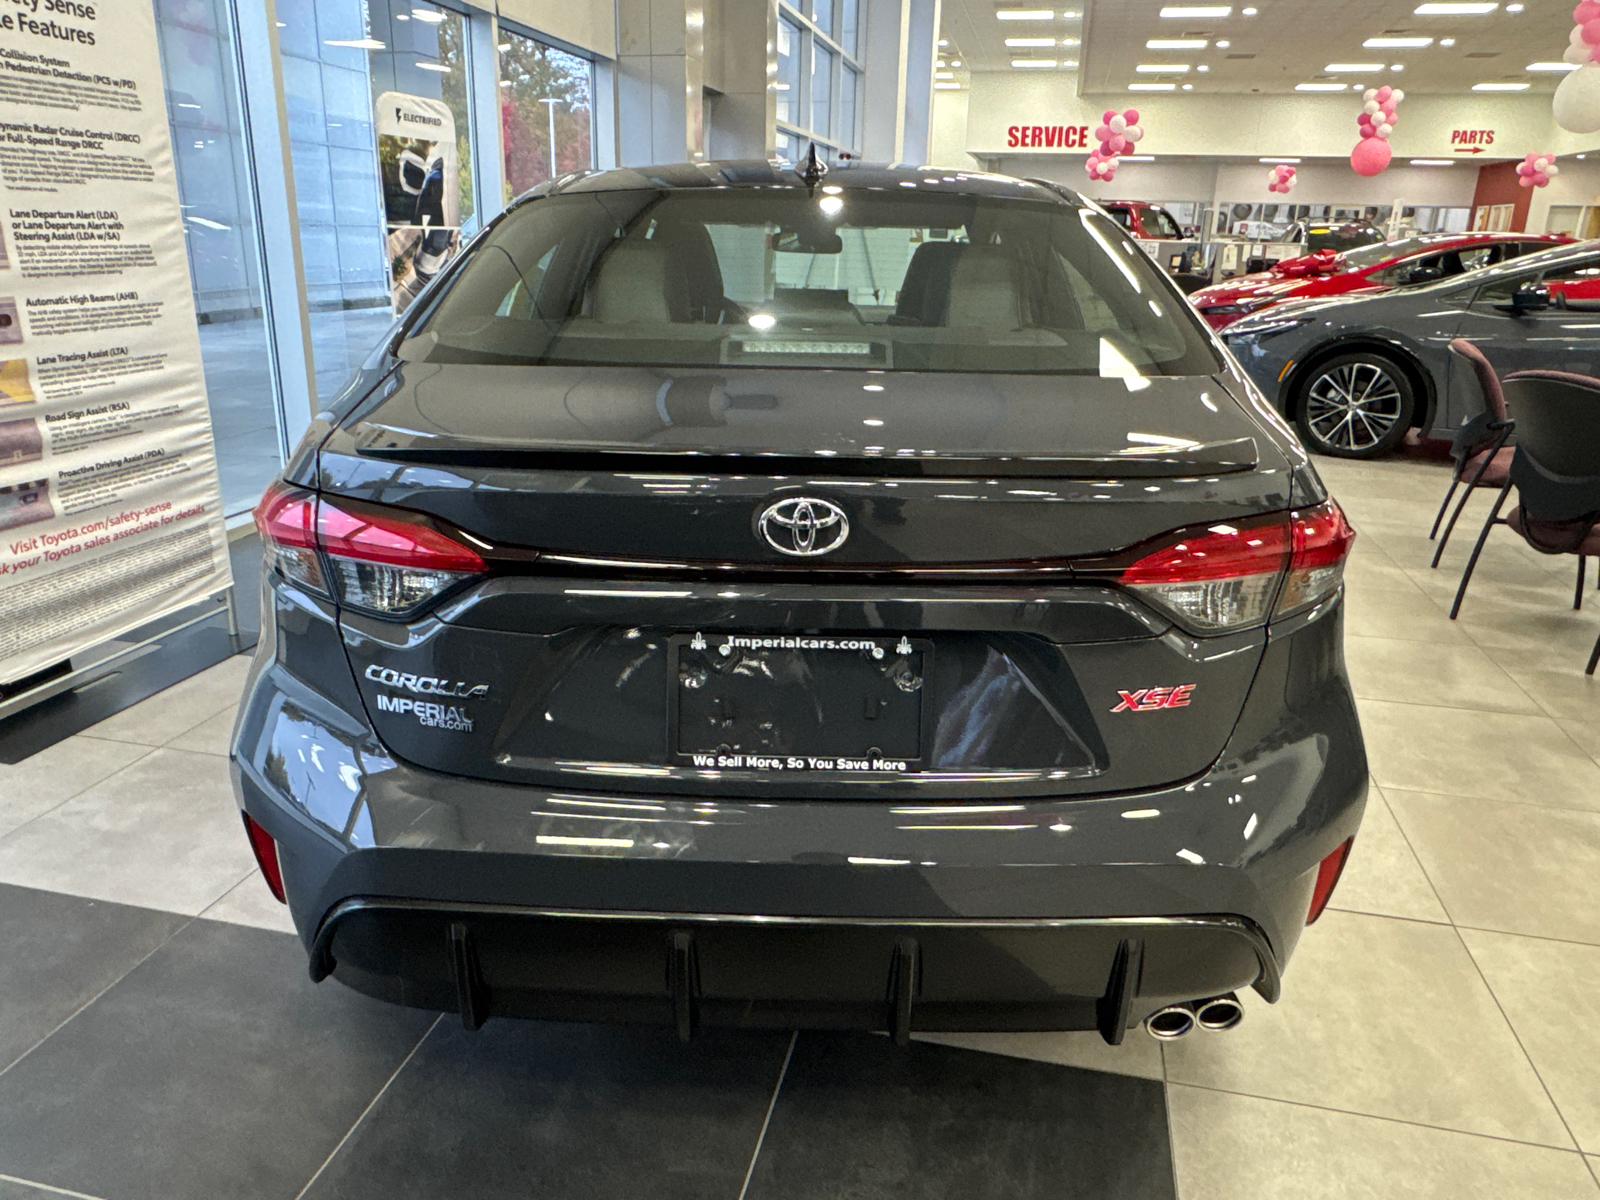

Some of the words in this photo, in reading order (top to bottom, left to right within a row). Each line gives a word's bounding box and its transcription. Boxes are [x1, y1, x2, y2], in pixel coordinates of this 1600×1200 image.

[44, 0, 96, 20] Sense
[0, 15, 14, 29] e
[17, 12, 96, 45] Features
[39, 54, 70, 68] System
[5, 61, 52, 76] Pedestrian
[52, 68, 92, 82] Detection
[93, 74, 112, 86] (PCS
[112, 78, 136, 90] w/PD)
[403, 113, 442, 126] ELECTRIFIED
[7, 133, 53, 147] Full-Speed
[55, 138, 81, 150] Range
[82, 140, 104, 150] DRCC
[33, 124, 58, 135] Radar
[59, 127, 84, 138] Cruise
[84, 130, 113, 140] Control
[114, 132, 141, 144] (DRCC)
[1007, 126, 1089, 148] SERVICE
[1451, 130, 1495, 145] PARTS
[9, 209, 31, 218] Lane
[31, 210, 75, 220] Departure
[76, 210, 97, 219] Alert
[97, 211, 118, 220] (LDA)
[22, 221, 44, 230] Lane
[45, 221, 86, 231] Departure
[87, 221, 107, 230] Alert
[107, 222, 124, 230] with
[13, 232, 50, 242] Steering
[51, 232, 76, 240] Assist
[76, 231, 96, 241] (LDA
[97, 231, 120, 241] w/SA)
[26, 297, 69, 306] Automatic
[69, 295, 89, 305] High
[90, 294, 115, 303] Beams
[116, 291, 138, 302] (AHB)
[36, 356, 56, 365] Lane
[57, 352, 86, 362] Tracing
[87, 349, 109, 358] Assist
[110, 346, 128, 357] (LTA)
[45, 413, 66, 423] Road
[67, 410, 85, 420] Sign
[86, 406, 108, 417] Assist
[109, 402, 130, 413] (RSA)
[58, 467, 94, 478] Proactive
[95, 459, 122, 471] Driving
[123, 454, 143, 465] Assist
[144, 448, 165, 460] (PDA)
[9, 539, 39, 555] Visit
[40, 501, 172, 547] Toyota.com/safety-sense
[11, 556, 41, 575] your
[43, 544, 81, 563] Toyota
[83, 535, 110, 549] sales
[113, 520, 159, 542] associate
[160, 514, 174, 528] for
[175, 503, 205, 520] details
[727, 635, 876, 650] Imperialcars.com
[364, 664, 490, 700] COROLLA
[1109, 683, 1197, 713] XSE
[377, 694, 474, 724] IMPERIAL
[419, 715, 474, 733] cars.com
[693, 755, 716, 767] We
[718, 755, 742, 768] Sell
[746, 756, 784, 769] More,
[787, 757, 805, 769] So
[808, 757, 833, 769] You
[836, 758, 869, 770] Save
[872, 759, 906, 771] More
